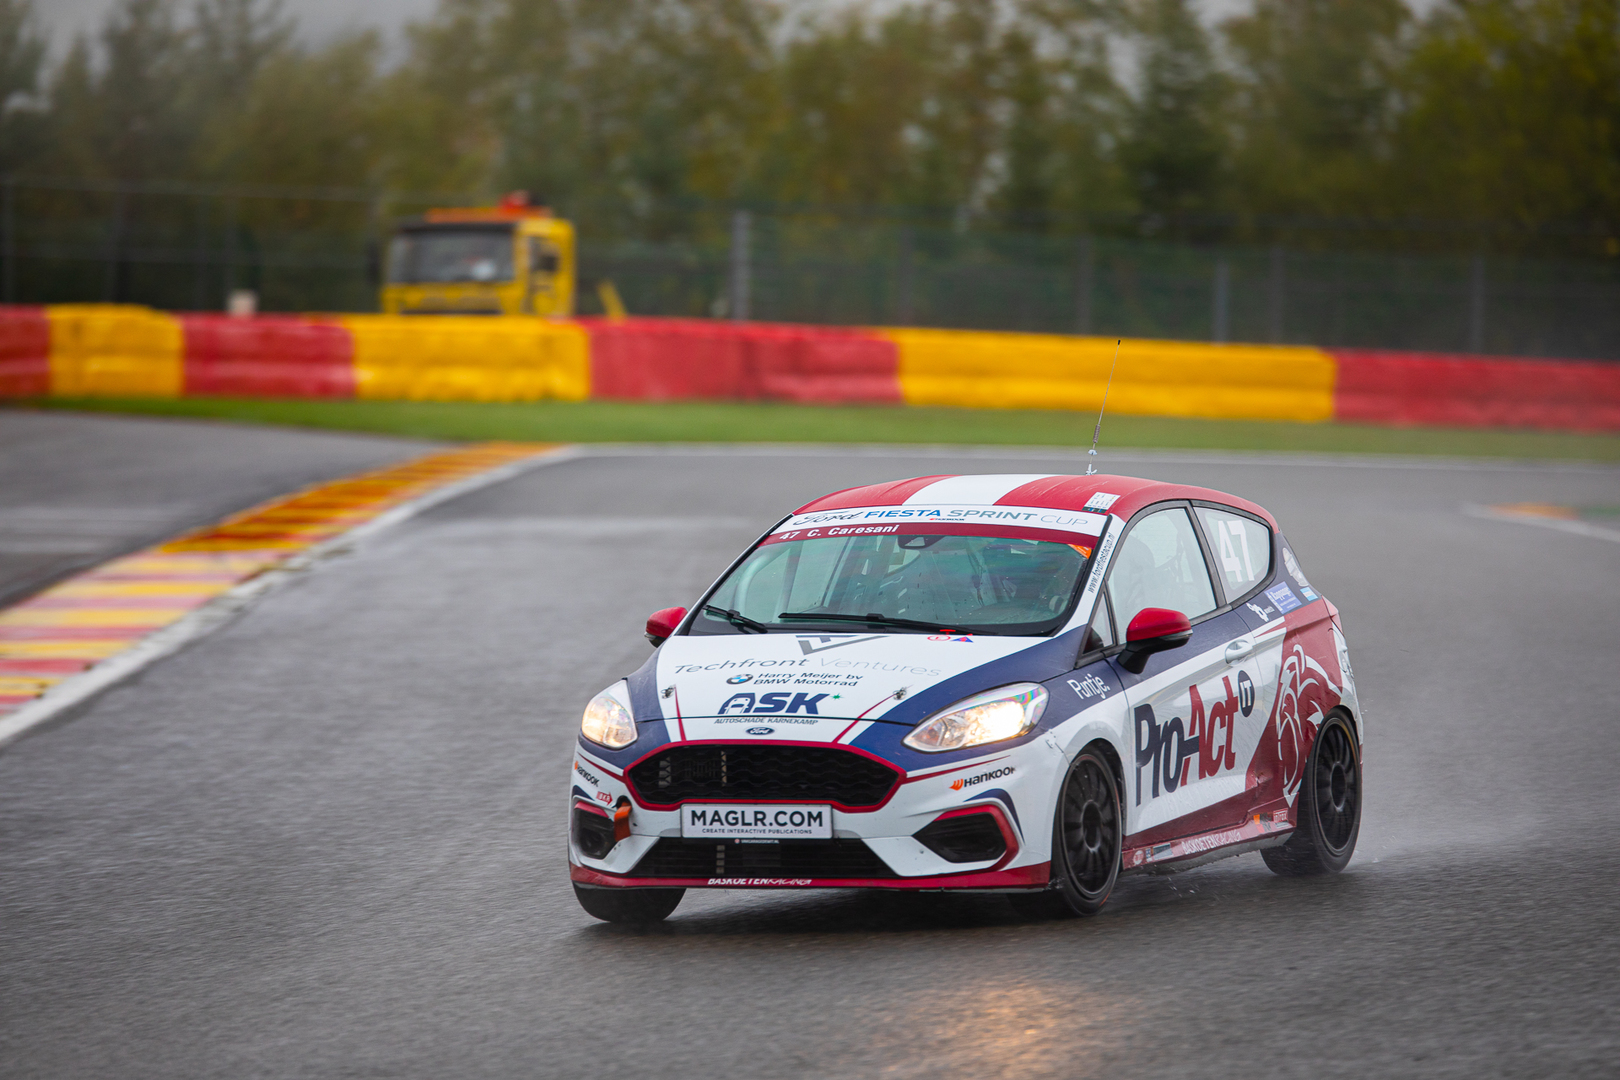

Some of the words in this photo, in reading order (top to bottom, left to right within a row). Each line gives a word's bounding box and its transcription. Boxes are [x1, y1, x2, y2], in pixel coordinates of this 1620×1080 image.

[864, 509, 940, 519] FIESTA
[947, 509, 1037, 521] SPRINT
[1040, 514, 1088, 526] CUP
[779, 531, 801, 540] 47
[807, 528, 822, 538] C.
[828, 524, 900, 536] Caresani
[1218, 520, 1255, 582] 47
[675, 658, 810, 674] Techfront
[820, 657, 941, 677] Ventures
[753, 678, 791, 686] BMW
[793, 678, 858, 687] Motorrad
[800, 672, 842, 680] Meijer
[717, 692, 831, 715] ASK
[767, 717, 819, 726] KARNEKAMP
[691, 810, 823, 827] MAGLR.COM
